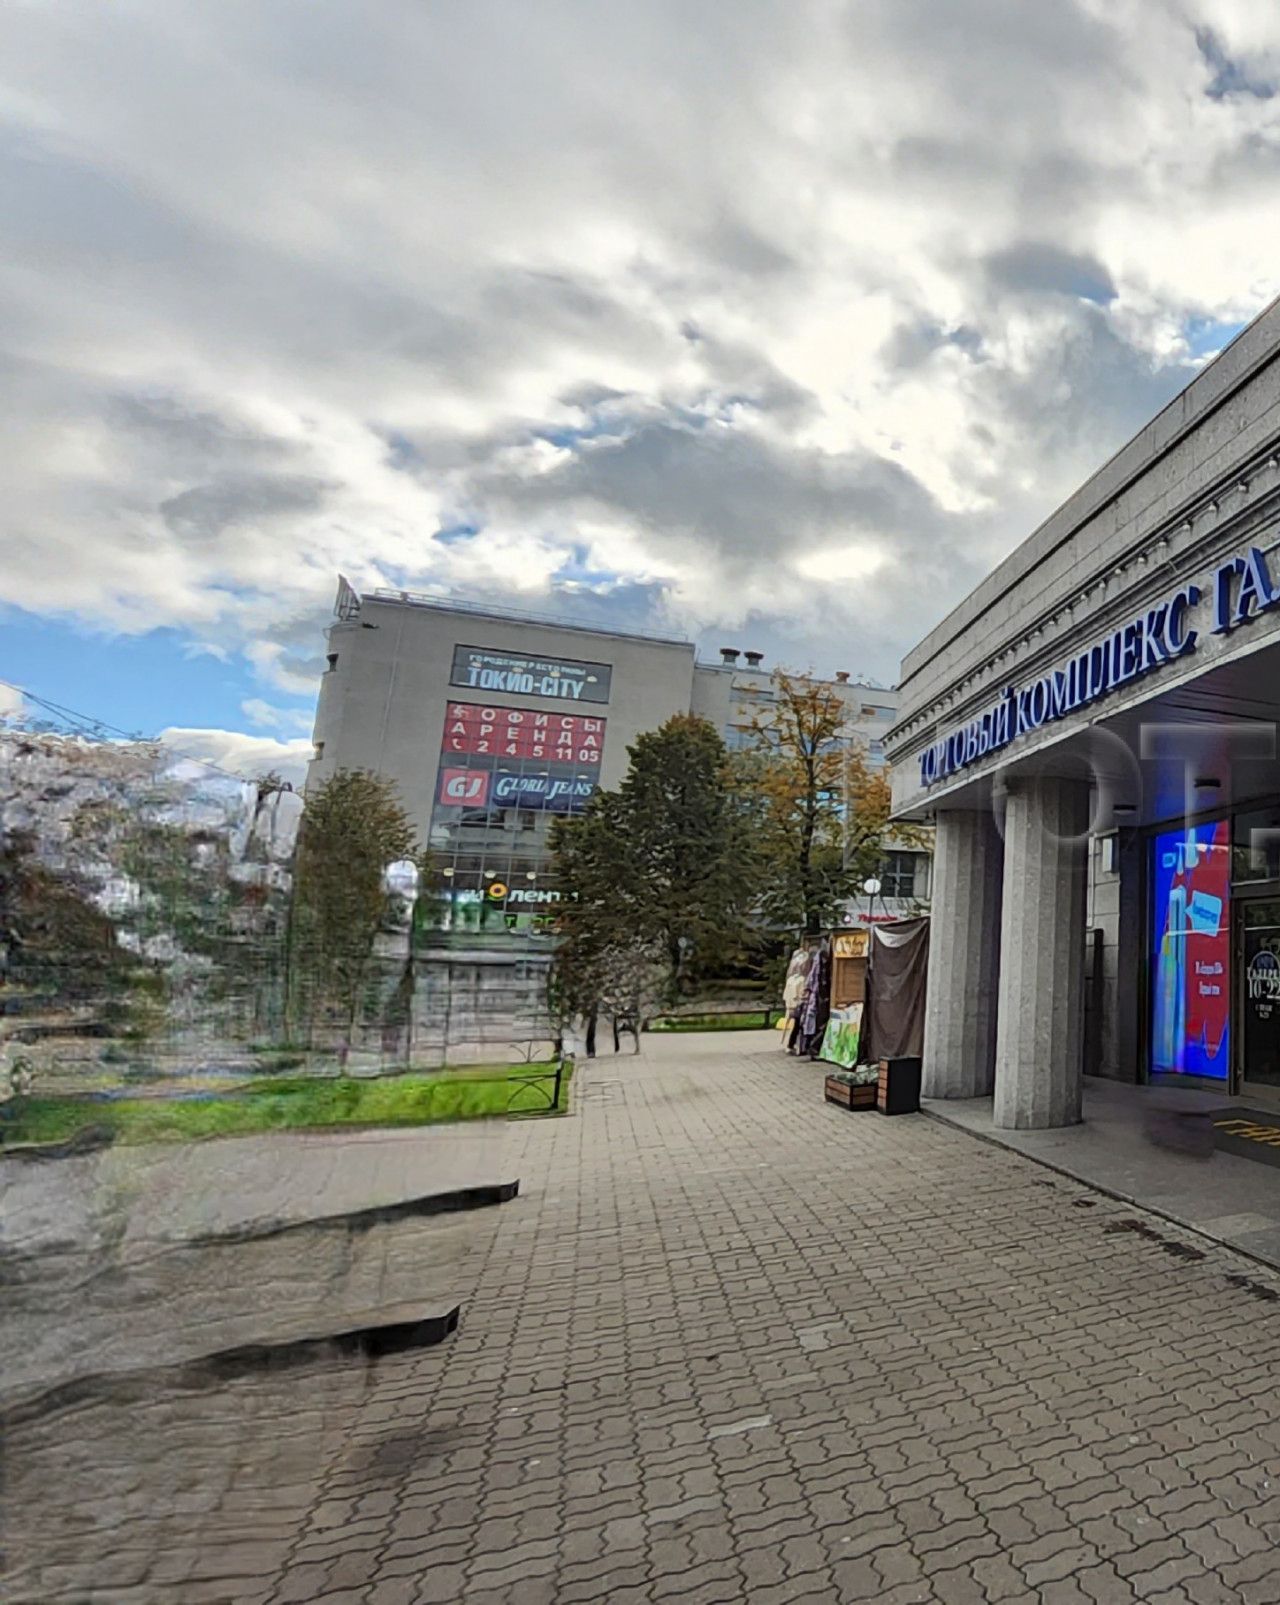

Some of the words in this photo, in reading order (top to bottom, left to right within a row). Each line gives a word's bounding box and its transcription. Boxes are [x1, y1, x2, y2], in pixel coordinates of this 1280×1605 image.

[918, 686, 1017, 787] ТОРГОВЫЙ
[1015, 584, 1202, 738] КОМПЛЕКС
[451, 722, 598, 747] АРЕНДА
[447, 776, 481, 798] GJ
[547, 781, 593, 800] JEANS
